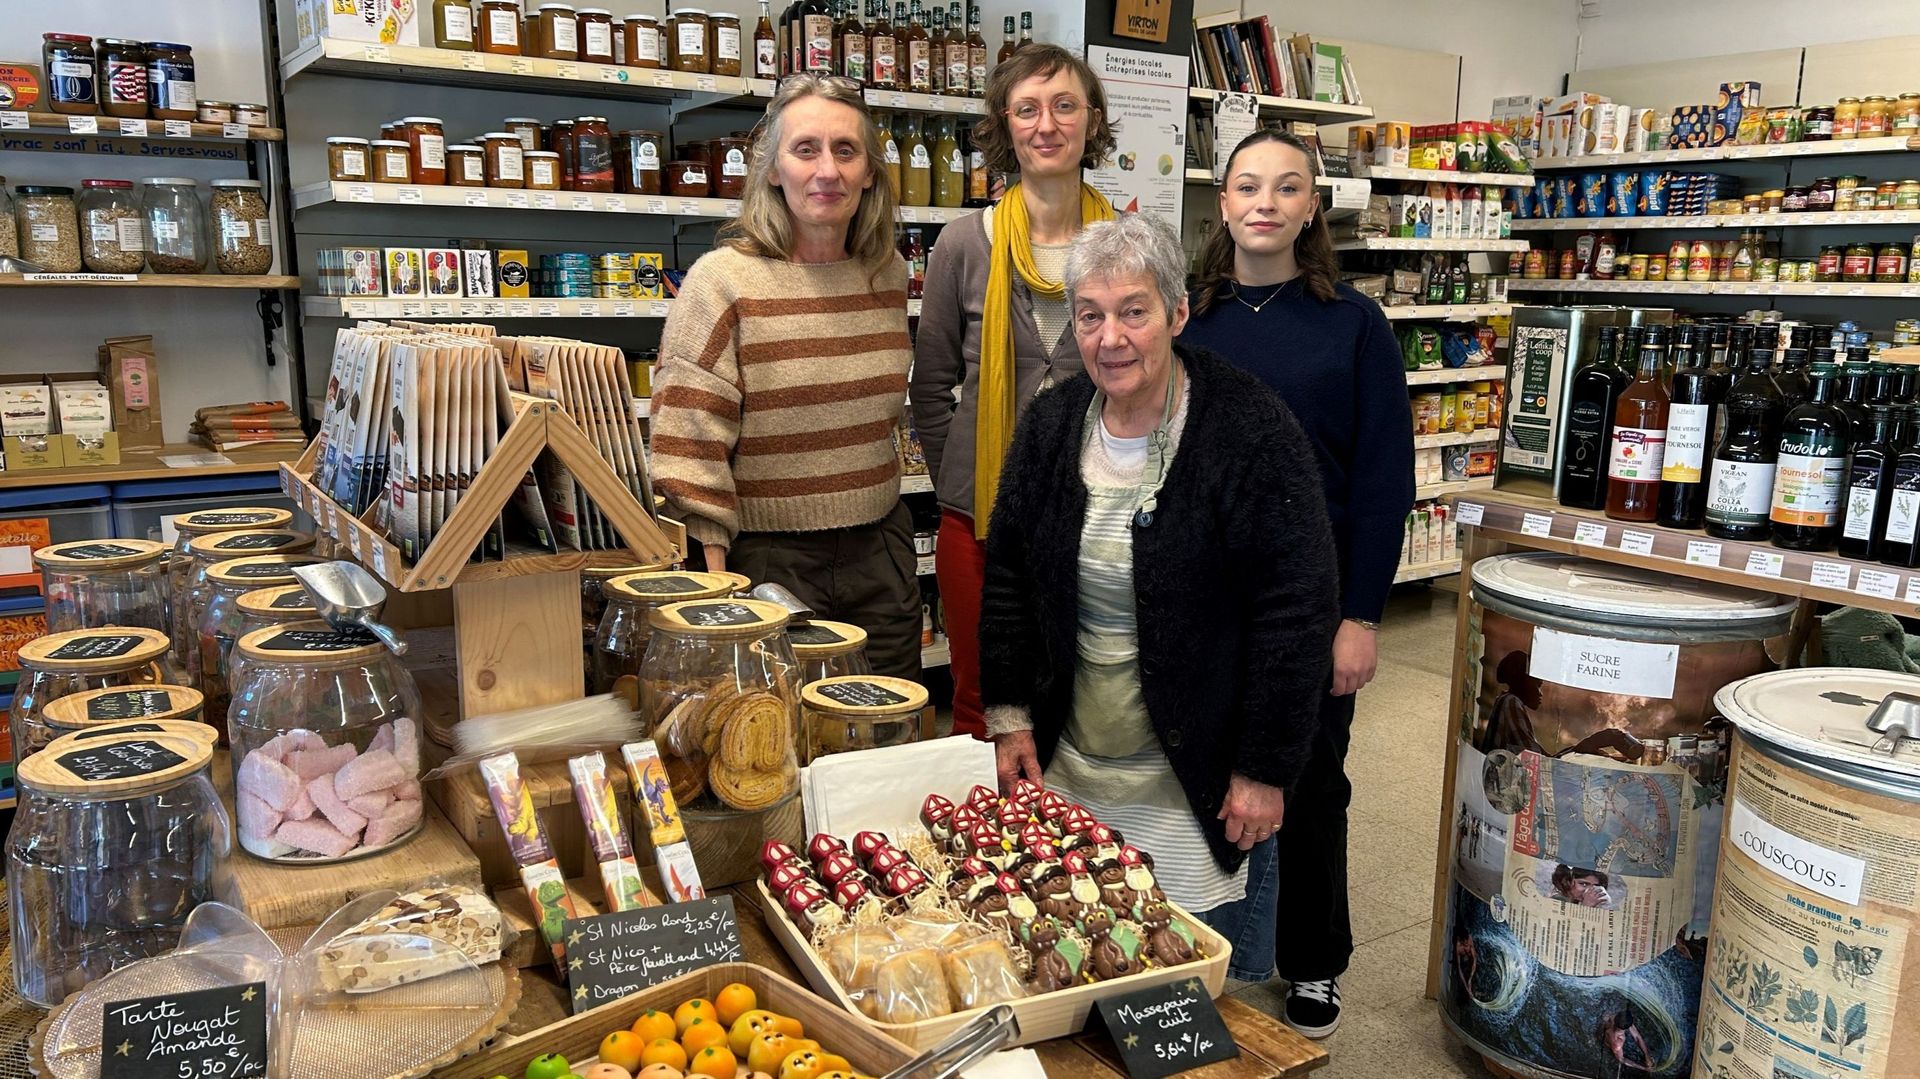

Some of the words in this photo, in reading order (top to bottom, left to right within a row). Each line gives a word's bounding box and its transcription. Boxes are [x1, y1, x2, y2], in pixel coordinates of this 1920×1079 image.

[1128, 14, 1159, 30] VIRTON
[1105, 52, 1136, 65] Énergies
[1138, 57, 1162, 68] locales
[1105, 64, 1146, 75] Entreprises
[1148, 69, 1172, 78] locales
[4, 139, 43, 150] vrac
[53, 138, 87, 150] sont
[95, 140, 114, 153] ici
[1535, 350, 1553, 358] coop
[1667, 441, 1703, 449] TOURNESOL
[1720, 469, 1748, 477] VIGEAN
[1711, 503, 1750, 513] KOOLZAAD
[1717, 497, 1742, 506] COLZA
[1580, 651, 1621, 667] SUCRE
[1577, 664, 1622, 680] FARINE
[1515, 817, 1531, 849] l'âge
[1786, 893, 1806, 908] fiche
[1807, 902, 1842, 921] pratique
[587, 922, 604, 941] St
[611, 917, 657, 937] Nicolas
[662, 912, 697, 927] Rond
[1810, 916, 1855, 936] quotidien
[588, 948, 607, 966] St
[611, 945, 645, 961] Nico
[608, 961, 640, 975] Père
[594, 983, 639, 999] Dragon
[109, 1000, 185, 1026] Tarte
[1117, 991, 1198, 1025] Massepain
[151, 1005, 241, 1044] Nougat
[1158, 1008, 1192, 1029] cuit
[146, 1031, 246, 1060] Amande
